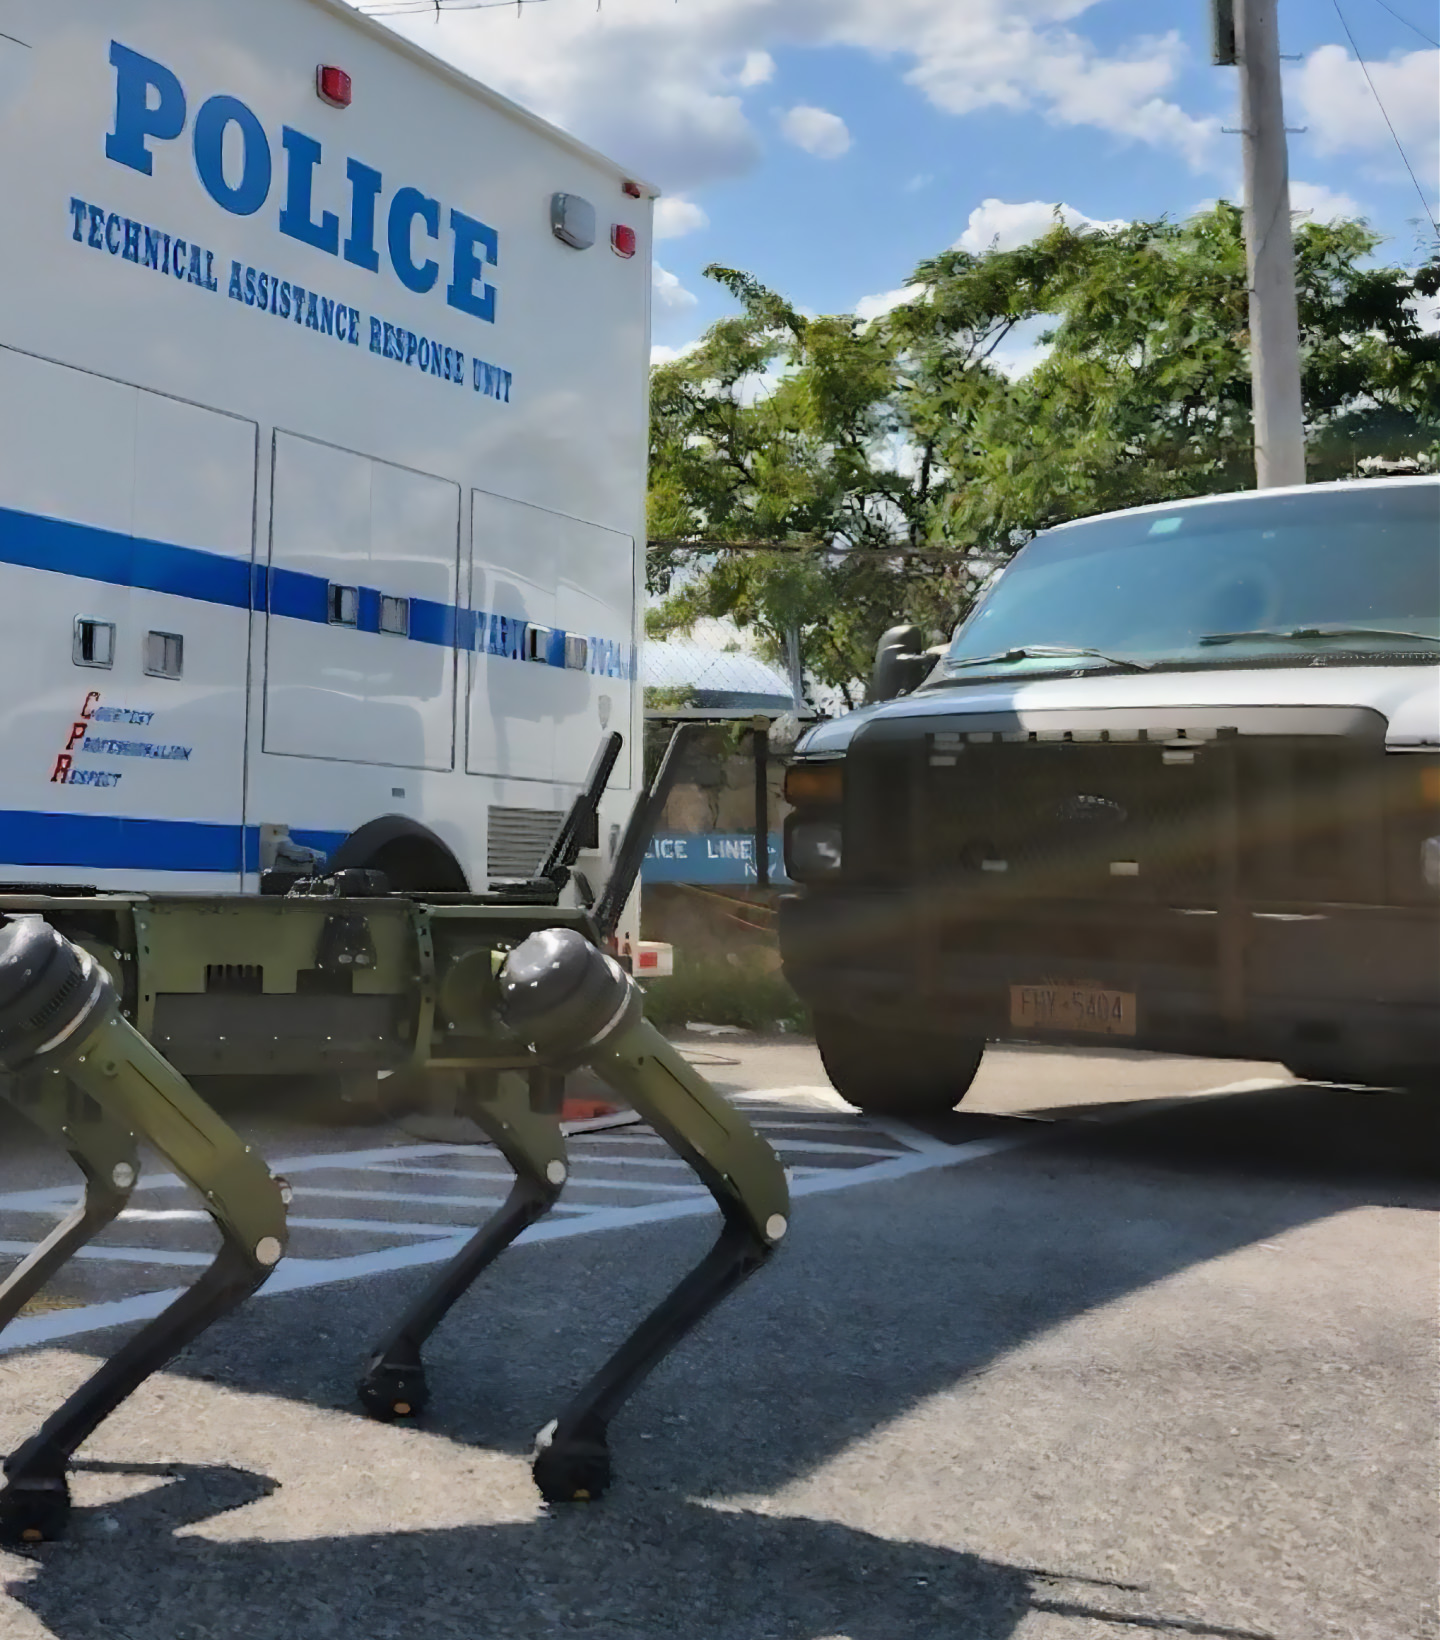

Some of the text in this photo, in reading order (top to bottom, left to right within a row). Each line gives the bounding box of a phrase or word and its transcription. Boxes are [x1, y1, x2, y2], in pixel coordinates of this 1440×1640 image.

[105, 39, 498, 324] POLICE
[69, 196, 513, 403] TECHNICAL ASSISTANCE RESPONSE UNIT
[707, 838, 752, 859] LINE
